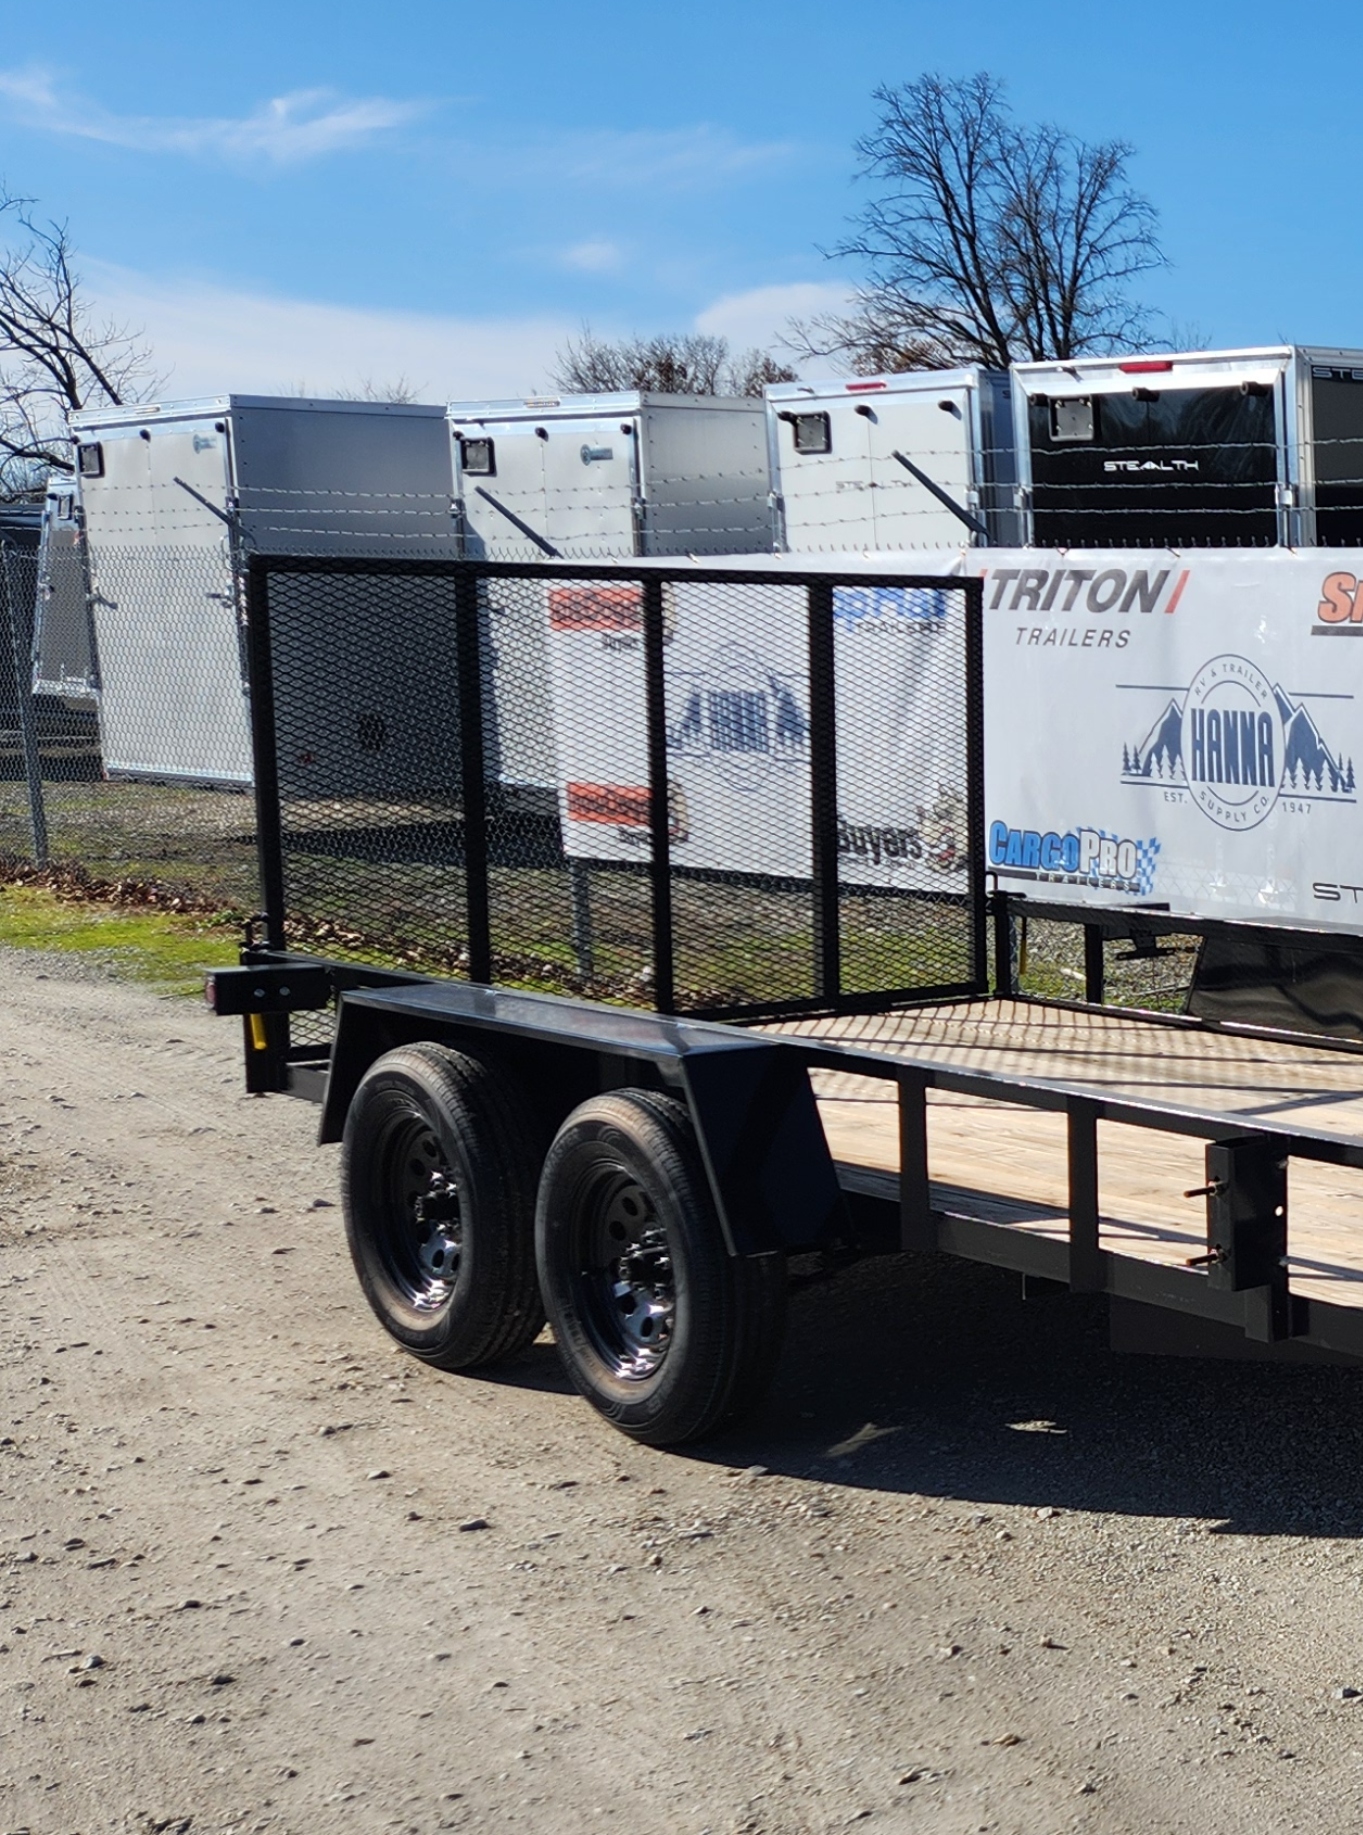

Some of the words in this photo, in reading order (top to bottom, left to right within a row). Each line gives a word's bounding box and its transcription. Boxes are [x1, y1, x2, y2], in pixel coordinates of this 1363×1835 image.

[1104, 460, 1199, 471] STEALTH
[989, 568, 1171, 613] TRITON
[1015, 627, 1131, 648] TRAILERS
[1222, 663, 1268, 700] TRAILER
[1191, 708, 1275, 787] HANNA
[1164, 791, 1188, 804] EST.
[1199, 790, 1247, 822] SUPPLY
[1282, 802, 1312, 814] 1947
